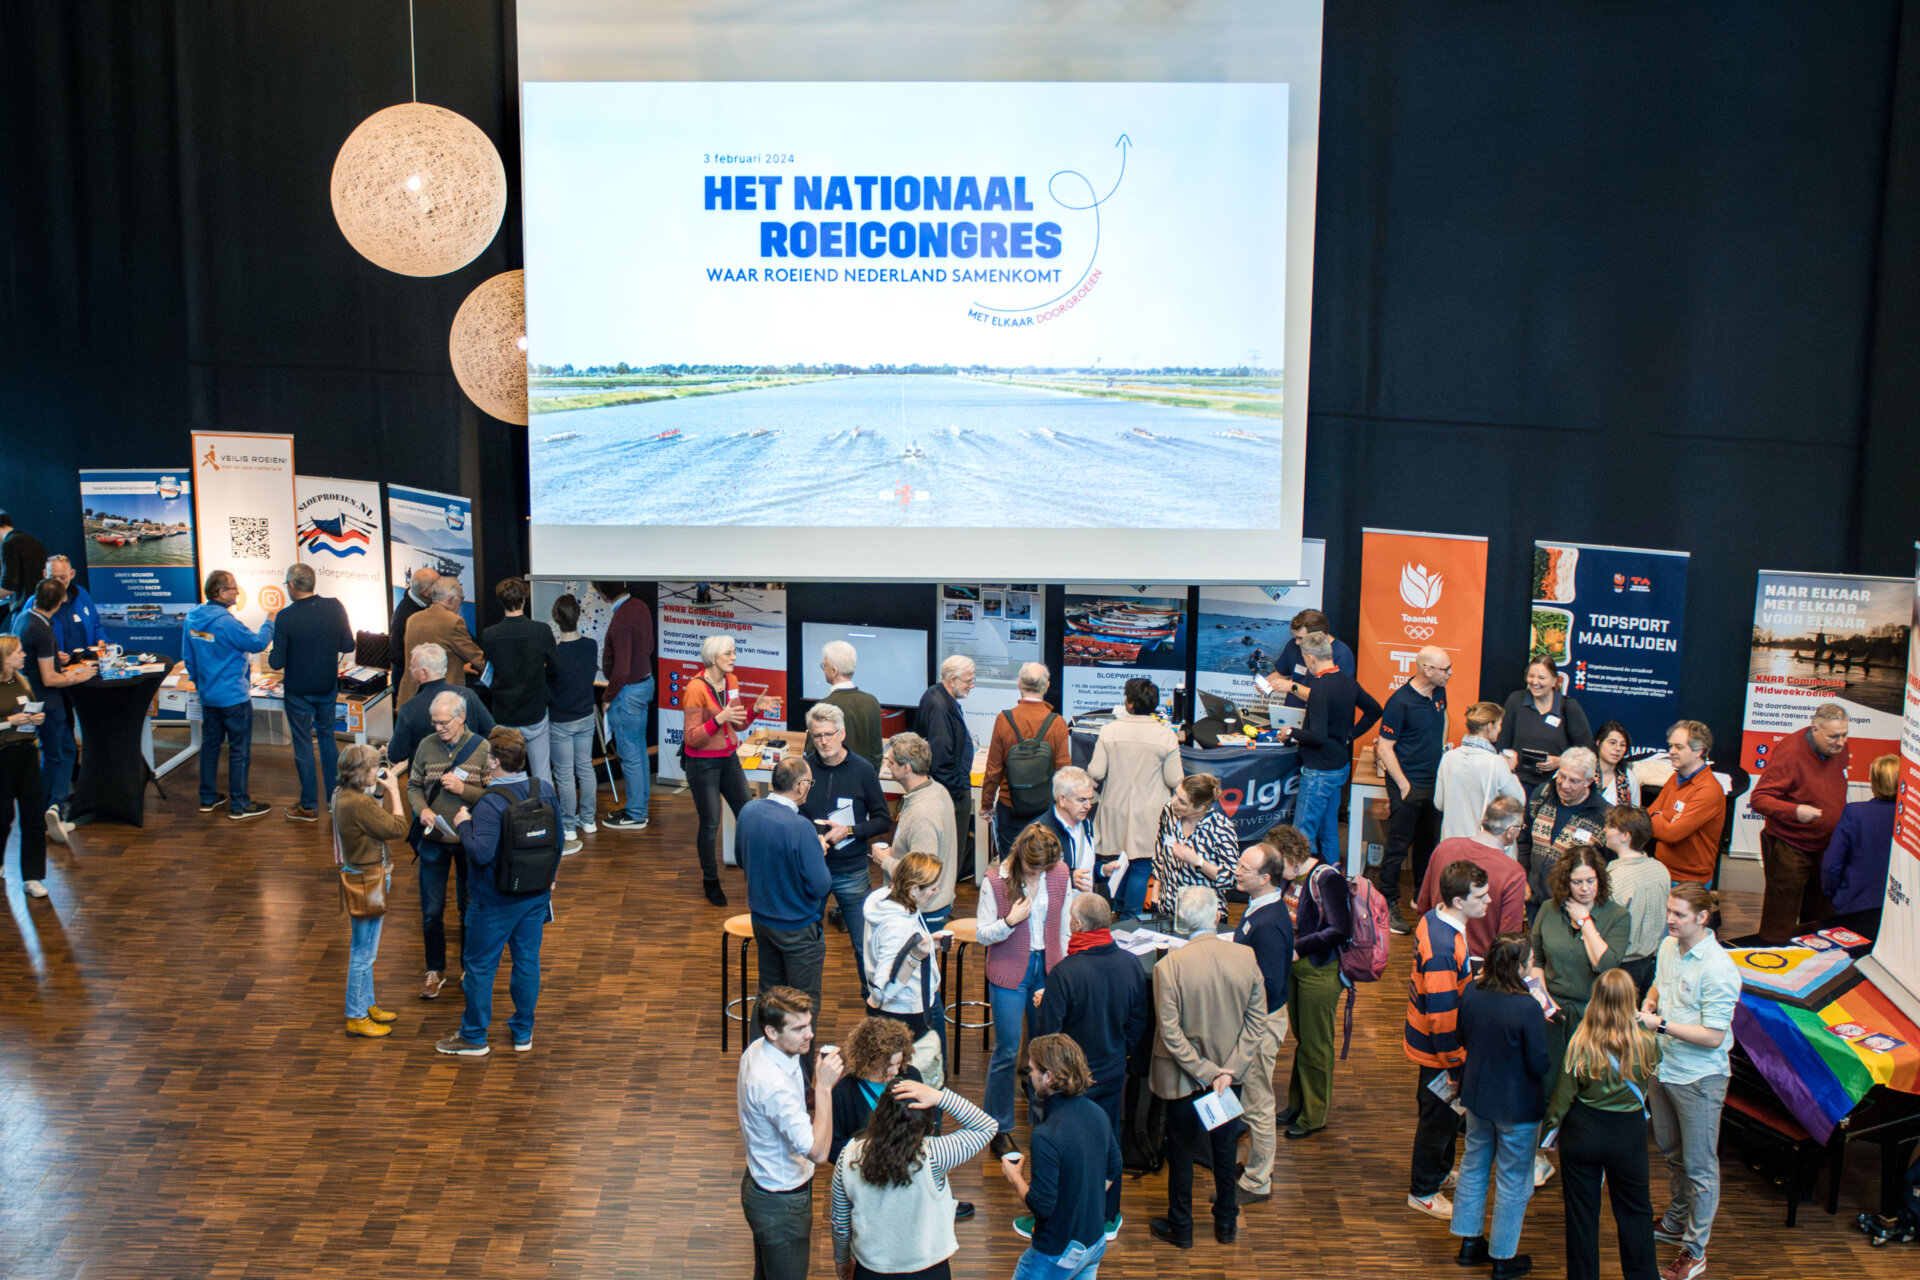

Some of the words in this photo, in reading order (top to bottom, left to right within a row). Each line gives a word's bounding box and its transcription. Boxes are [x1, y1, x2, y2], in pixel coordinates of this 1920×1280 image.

[703, 153, 710, 163] 3
[714, 153, 761, 163] februari
[765, 154, 795, 163] 2024
[704, 176, 782, 210] HET
[794, 175, 1034, 211] NATIONAAL
[760, 221, 1062, 258] ROEICONGRES
[706, 268, 758, 282] WAAR
[764, 268, 839, 282] ROEIEND
[844, 268, 947, 282] NEDERLAND
[952, 269, 1062, 283] SAMENKOMT
[967, 308, 990, 323] MET
[991, 316, 1035, 328] ELKAAR
[1036, 269, 1103, 324] DOORGROEIEN
[220, 455, 249, 463] VEILIG
[1765, 584, 1808, 598] NAAR
[1811, 587, 1871, 601] ELKAAR
[663, 604, 686, 613] KNRB
[688, 606, 735, 619] Commissie
[1763, 598, 1796, 611] MET
[1798, 600, 1857, 615] ELKAAR
[663, 615, 695, 625] Nieuwe
[696, 619, 753, 631] Verenigingen
[1401, 613, 1439, 625] TeamNL
[1588, 613, 1671, 633] TOPSPORT
[1762, 612, 1803, 625] VOOR
[1807, 615, 1866, 629] ELKAAR
[1578, 631, 1678, 653] MAALTIJDEN
[1756, 674, 1784, 684] KNRB
[1786, 676, 1846, 688] Commissie
[1755, 686, 1836, 698] Midweekroeien
